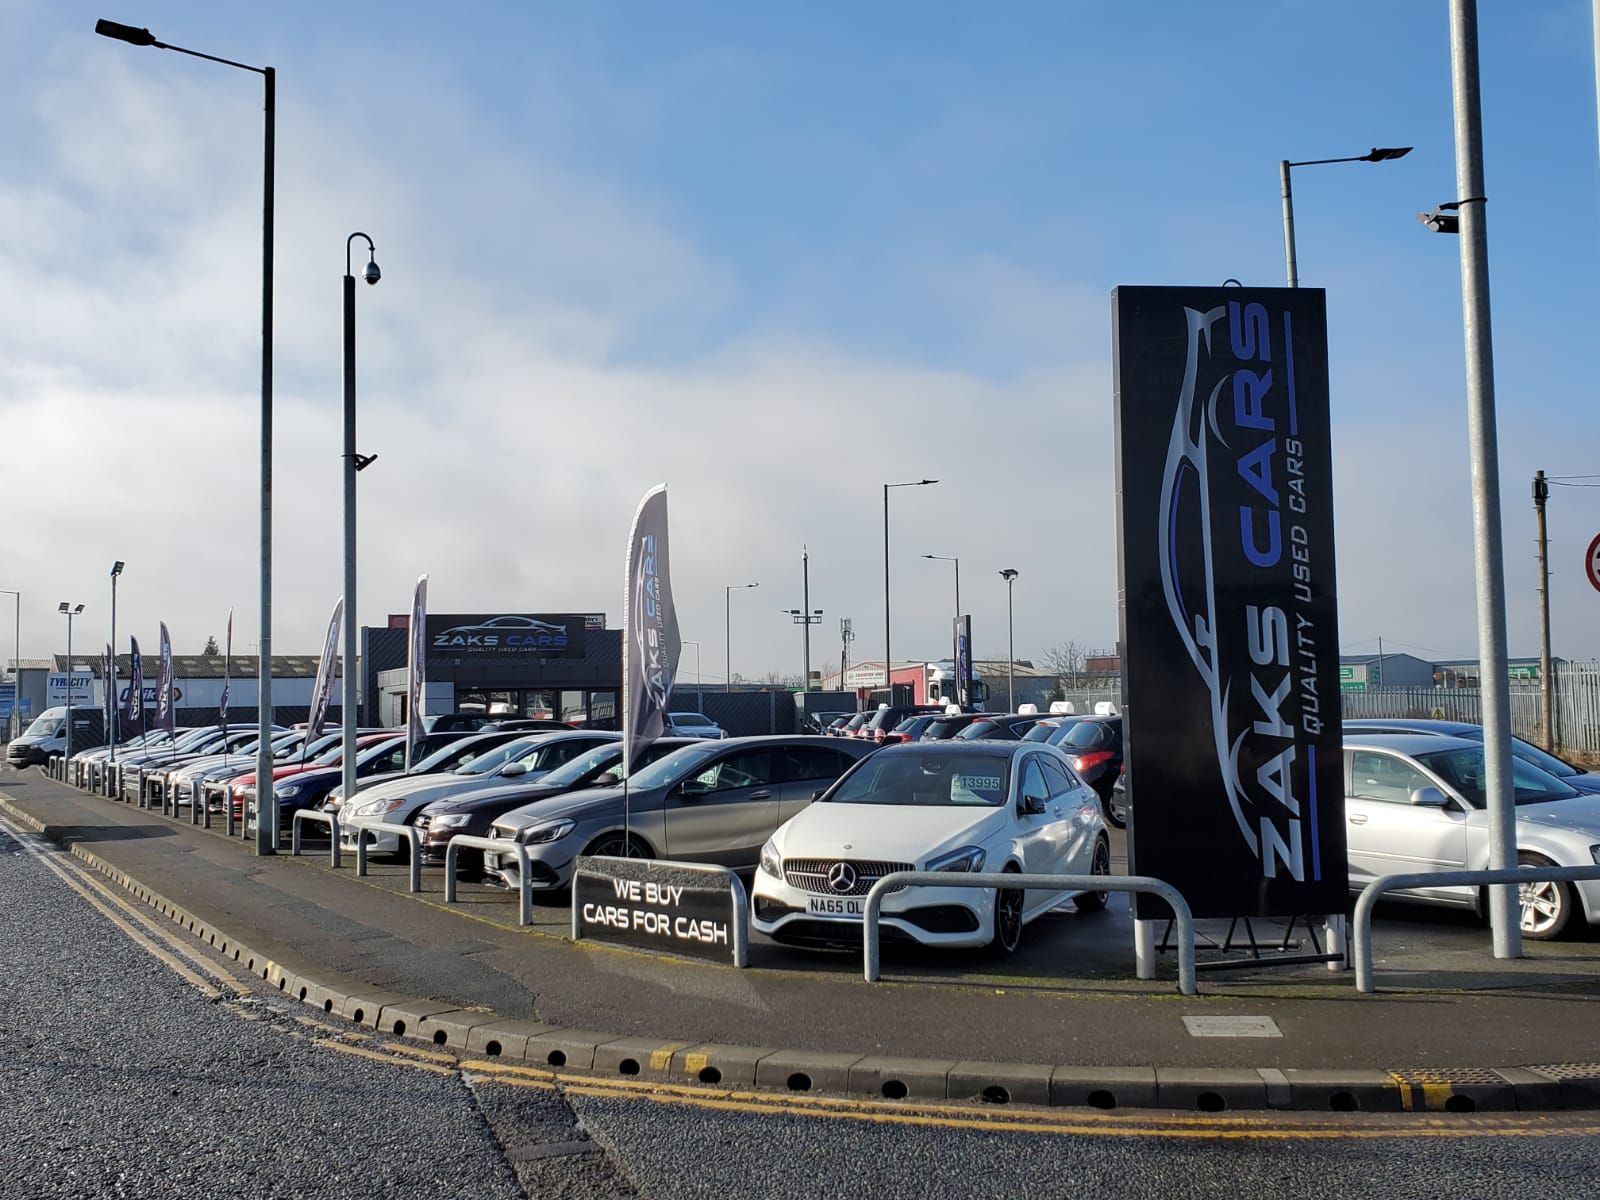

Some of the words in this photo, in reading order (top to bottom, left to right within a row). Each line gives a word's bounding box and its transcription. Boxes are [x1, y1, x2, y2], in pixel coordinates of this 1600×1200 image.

[1229, 301, 1283, 567] CARS
[1286, 438, 1307, 513] CARS
[646, 535, 657, 617] CARS
[1290, 525, 1311, 602] USED
[433, 635, 499, 646] ZAKS
[507, 635, 568, 646] CARS
[648, 628, 666, 710] ZAKS
[1296, 612, 1324, 735] QUALITY
[70, 677, 91, 687] CITY
[1246, 605, 1304, 881] ZAKS
[962, 777, 999, 789] 13995
[583, 903, 630, 929] CARS
[633, 911, 671, 936] FOR
[675, 917, 728, 945] CASH
[613, 878, 642, 901] WE
[645, 884, 684, 907] BUY
[811, 898, 843, 913] NA65
[847, 901, 866, 914] OL
